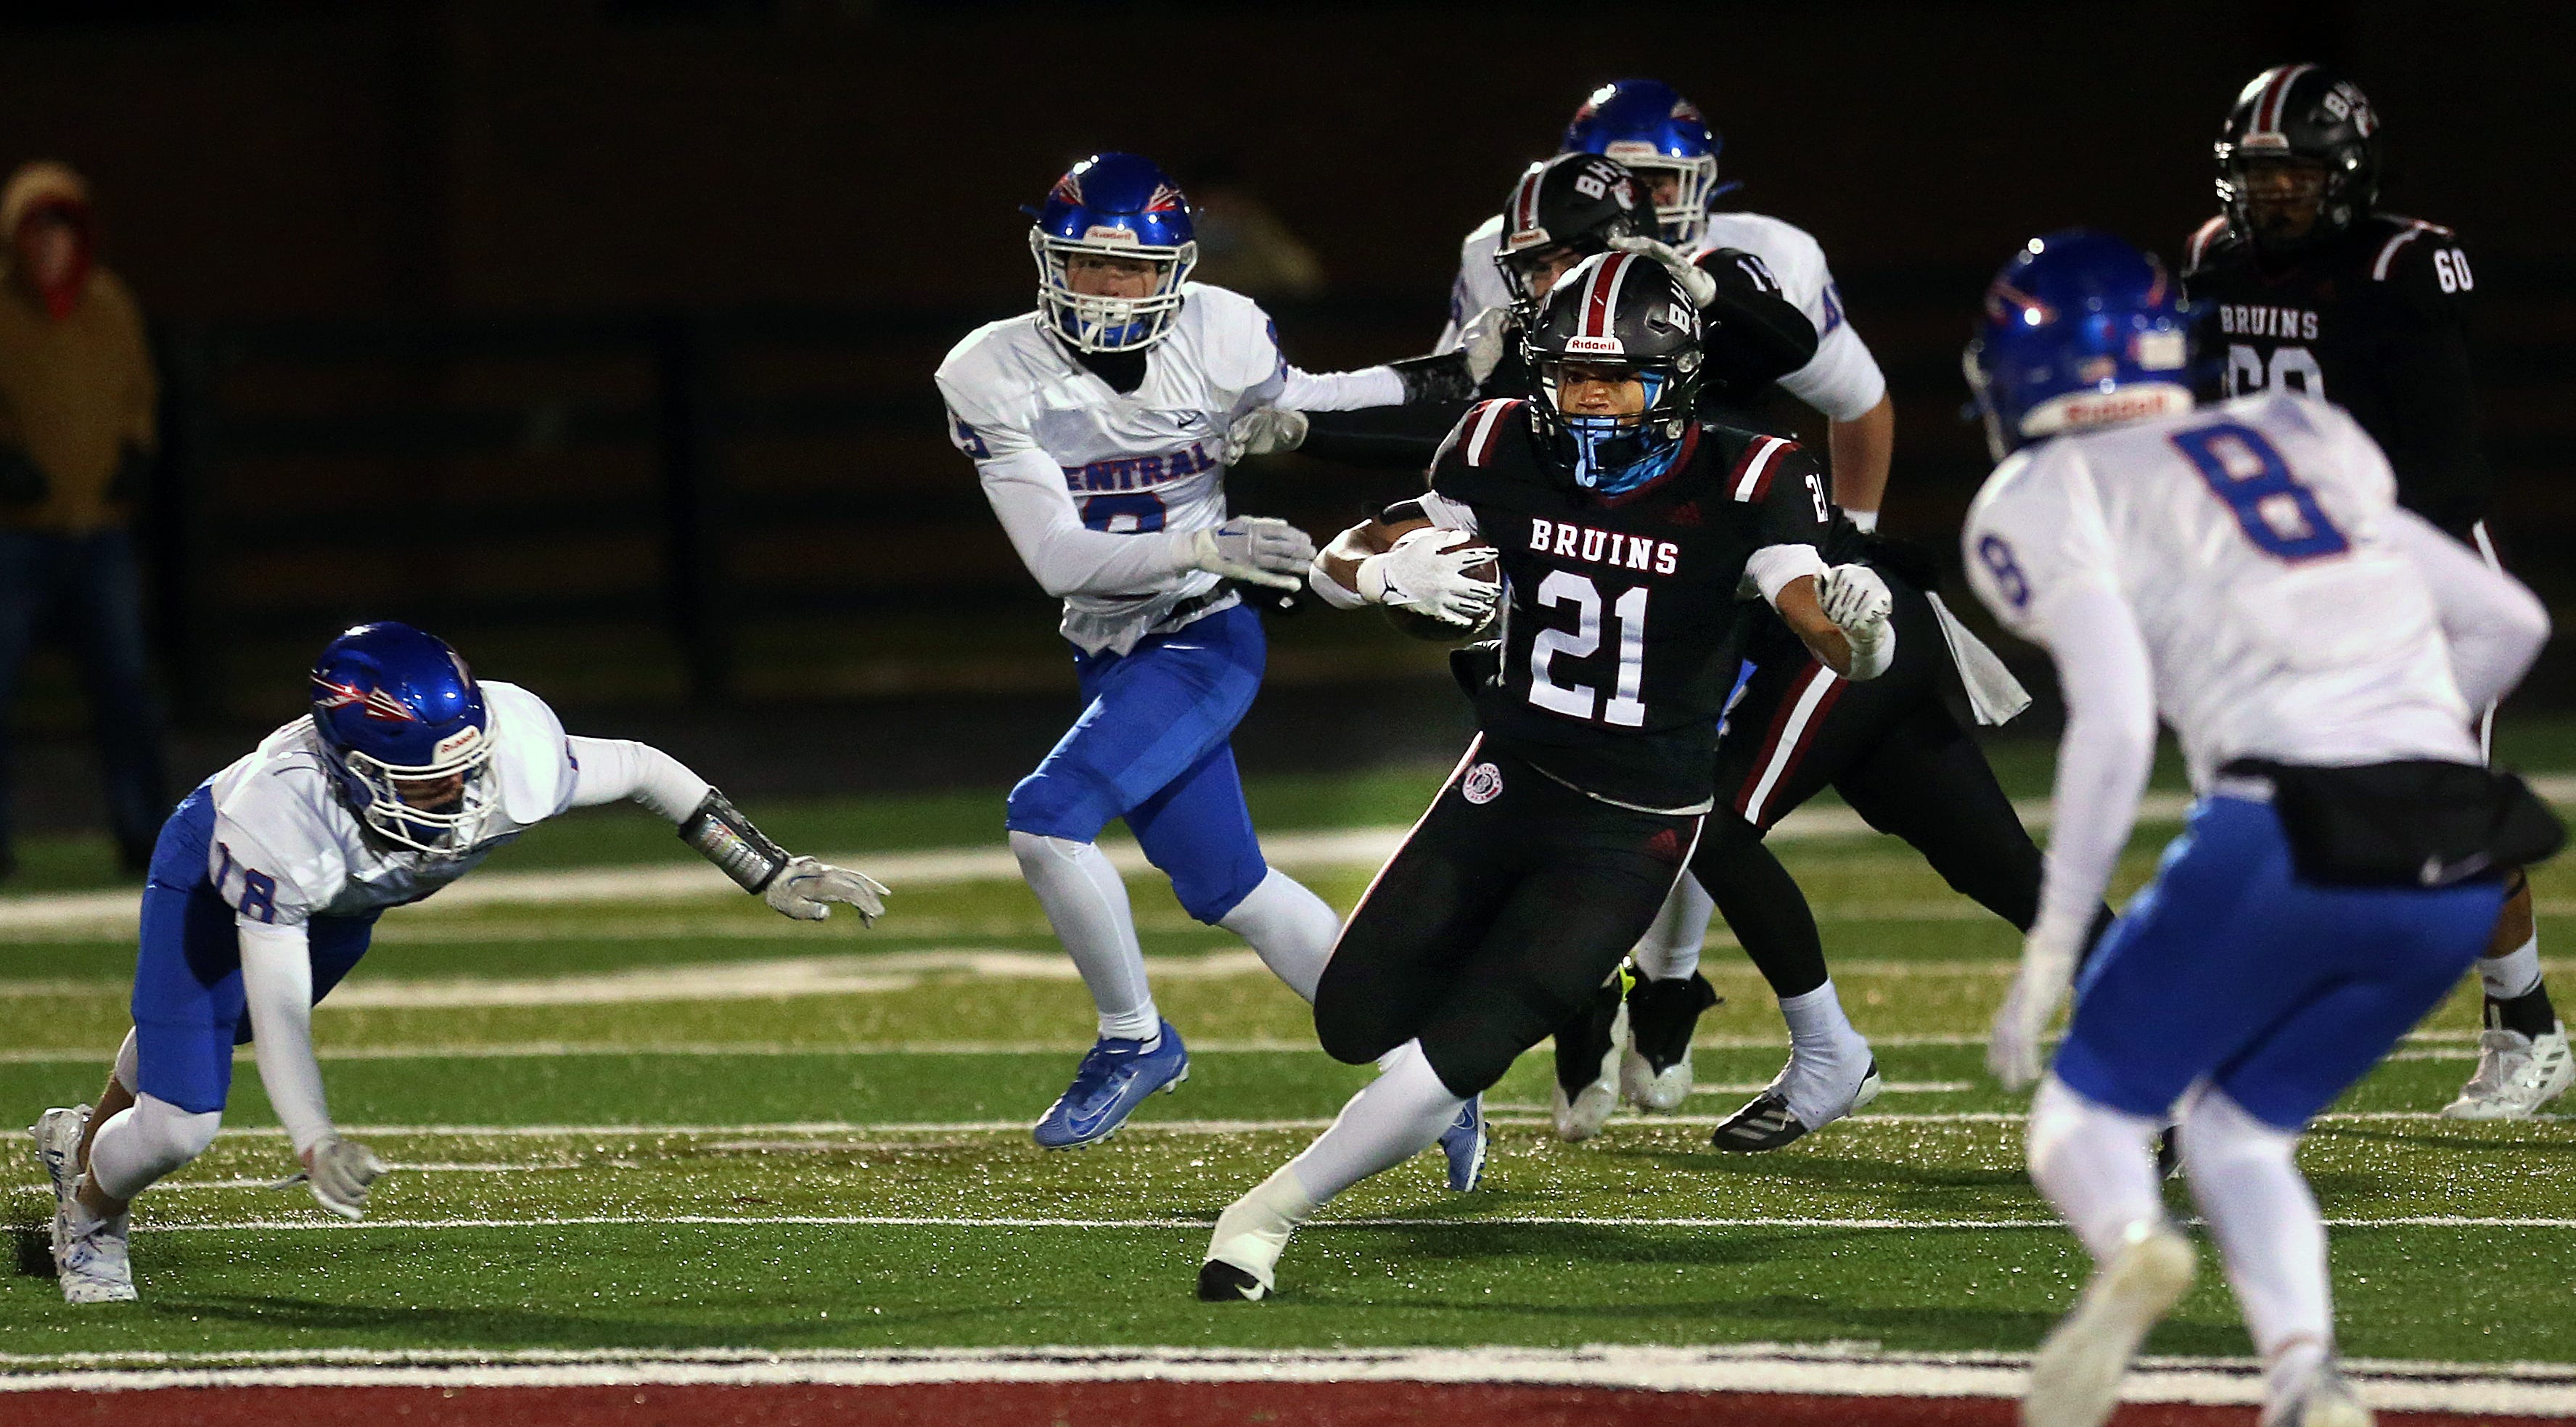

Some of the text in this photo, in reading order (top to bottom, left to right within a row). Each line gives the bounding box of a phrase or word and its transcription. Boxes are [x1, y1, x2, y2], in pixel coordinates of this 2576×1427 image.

[2434, 248, 2474, 294] 60
[1572, 340, 1615, 350] Riddell
[2220, 304, 2319, 340] BRUINS
[1060, 442, 1217, 491] ENTRAL
[2166, 421, 2351, 561] 8
[1805, 473, 1829, 522] 21
[1530, 518, 1678, 575] BRUINS
[1979, 535, 2030, 608] 8
[1528, 569, 1649, 727] 21
[216, 842, 277, 924] 18
